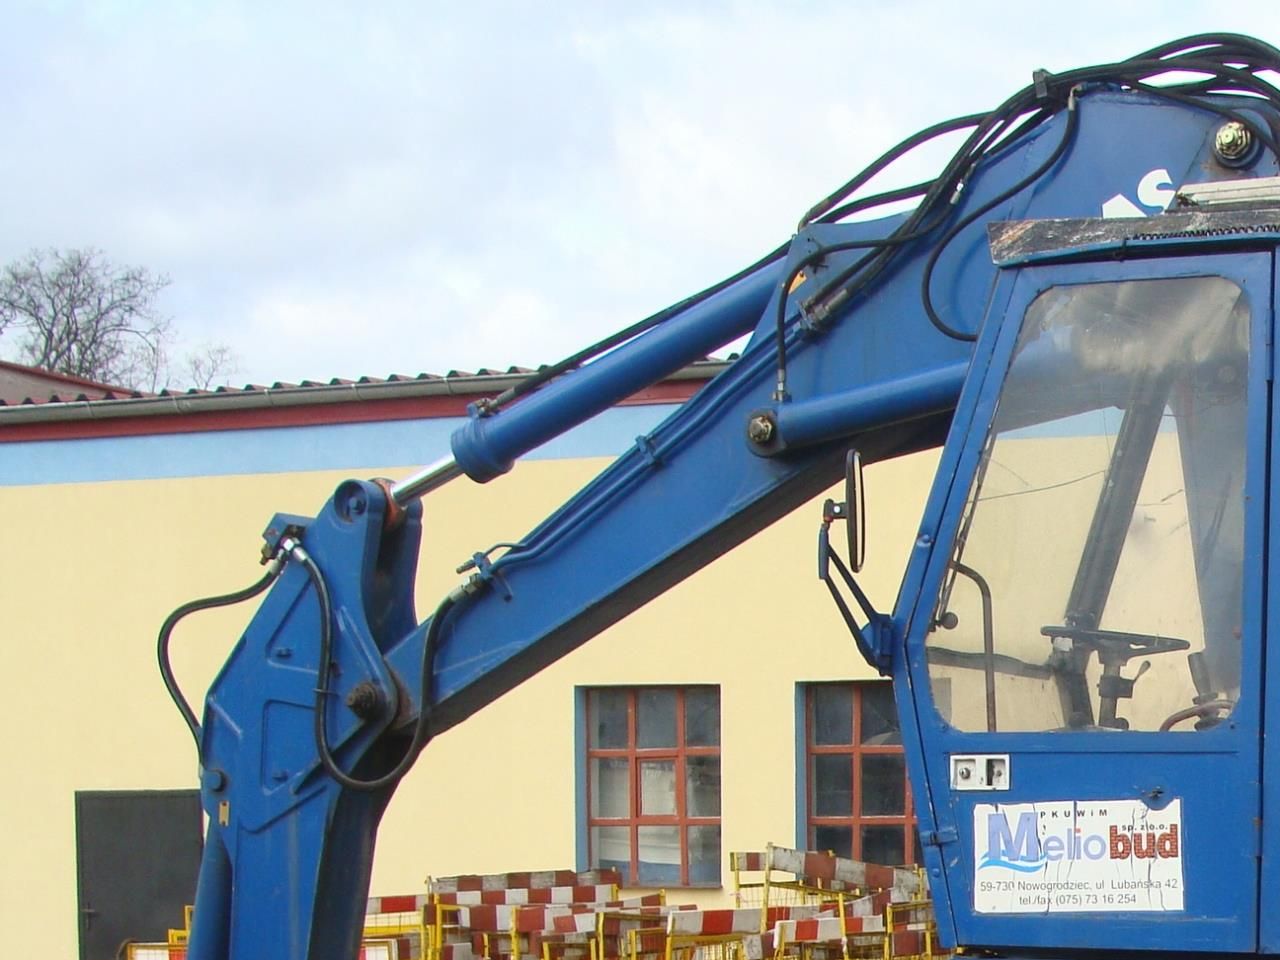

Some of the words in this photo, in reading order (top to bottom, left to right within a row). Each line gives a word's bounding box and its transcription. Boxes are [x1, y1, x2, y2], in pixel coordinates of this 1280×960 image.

[980, 881, 1015, 892] 59-730
[1164, 878, 1178, 889] 42
[1055, 894, 1082, 906] (075)
[1085, 894, 1098, 904] 73
[1102, 894, 1114, 904] 16
[1117, 893, 1136, 904] 254
